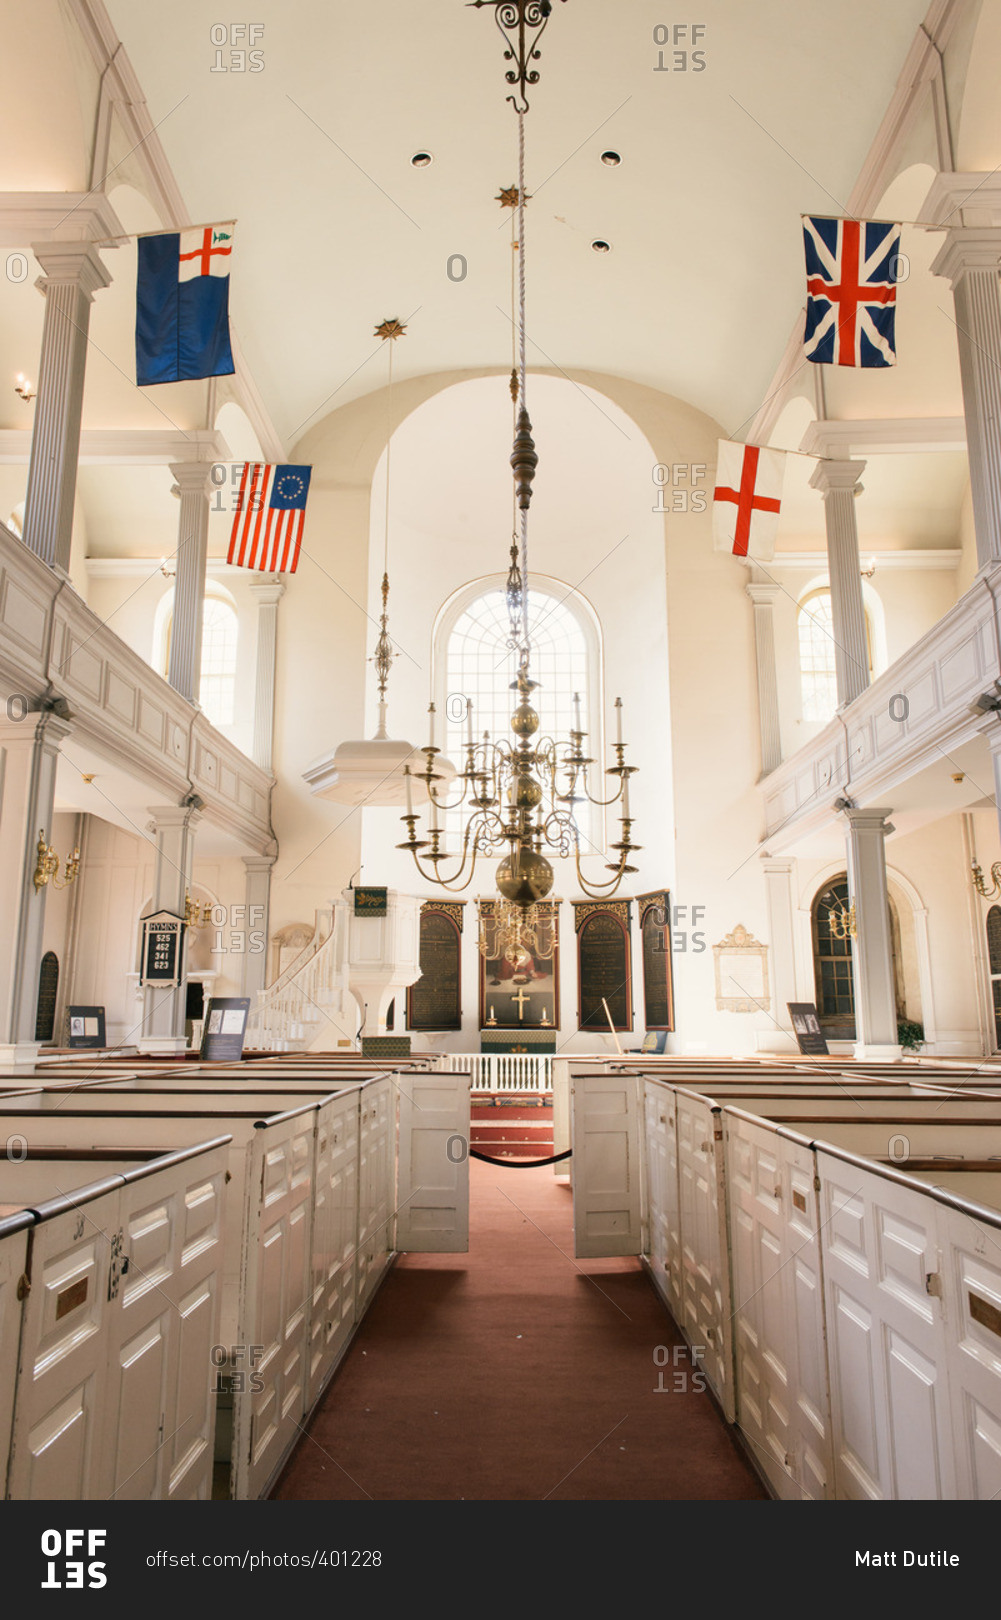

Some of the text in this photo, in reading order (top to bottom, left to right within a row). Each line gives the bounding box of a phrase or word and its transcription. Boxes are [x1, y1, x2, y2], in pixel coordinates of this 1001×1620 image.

[149, 923, 178, 931] HYMNS
[155, 943, 169, 951] 462
[154, 952, 169, 960] 341
[154, 961, 169, 970] 623
